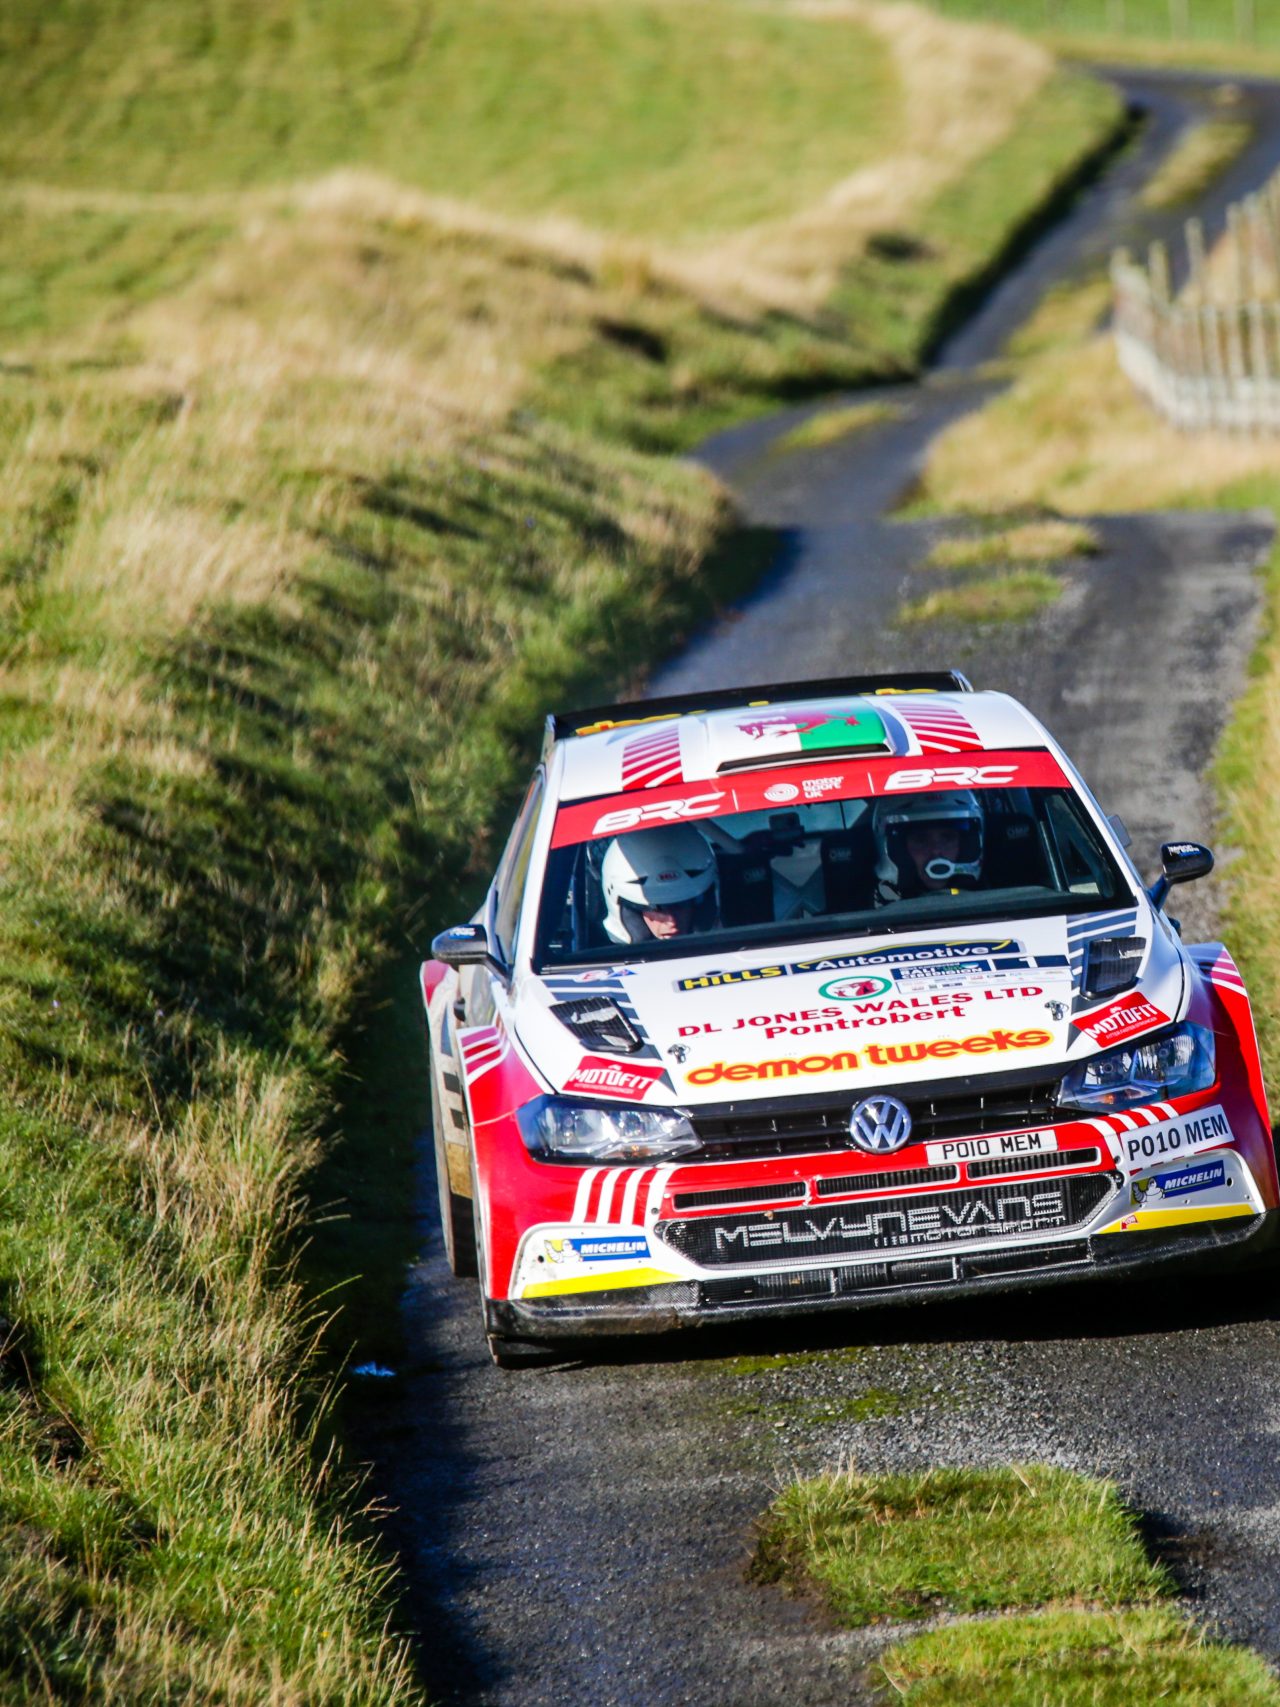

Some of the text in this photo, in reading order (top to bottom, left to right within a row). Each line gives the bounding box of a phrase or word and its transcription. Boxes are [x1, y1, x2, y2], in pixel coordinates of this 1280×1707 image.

[884, 765, 1019, 791] BRC
[592, 792, 726, 835] BRC
[684, 946, 989, 990] HILLS Automotive
[678, 986, 1043, 1037] DL JONES WALES LTD
[765, 1005, 966, 1039] Pontrobert
[1084, 1003, 1158, 1038] MOTOFIT
[686, 1029, 1052, 1086] demon tweeks
[568, 1068, 655, 1089] MOTOFIT
[942, 1133, 1042, 1160] PO10 MEM
[1127, 1113, 1229, 1161] PO10 MEM
[1164, 1167, 1223, 1190] MICHELIN
[581, 1241, 647, 1254] MICHELIN
